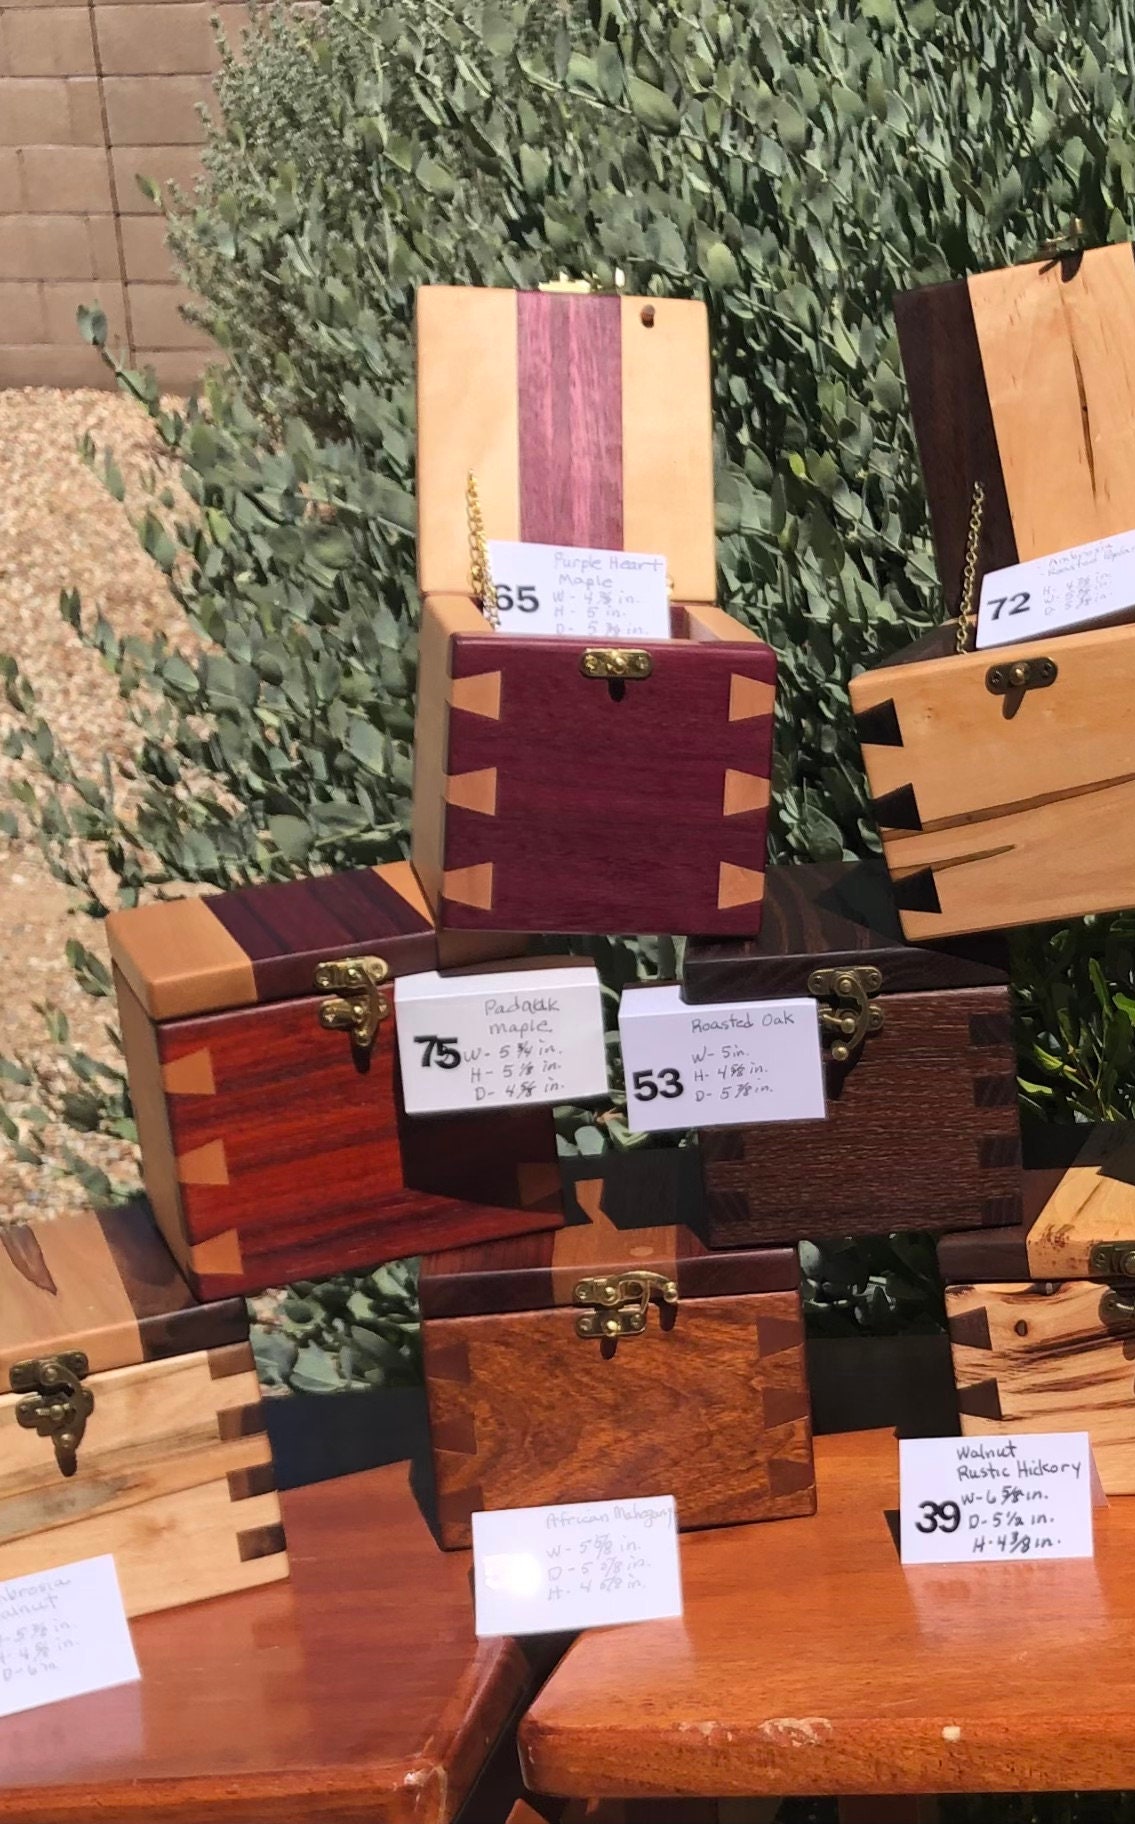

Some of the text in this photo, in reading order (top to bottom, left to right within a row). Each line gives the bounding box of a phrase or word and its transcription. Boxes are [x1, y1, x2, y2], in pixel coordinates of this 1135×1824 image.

[554, 552, 664, 572] Purple Heart
[558, 574, 613, 591] Maple
[495, 585, 539, 613] 65
[987, 592, 1031, 621] 72
[691, 1010, 795, 1034] Roasted Oak
[413, 1035, 461, 1069] 75
[538, 1039, 563, 1056] in.
[542, 1060, 562, 1073] in.
[750, 1062, 768, 1075] in.
[544, 1077, 565, 1093] in.
[632, 1067, 684, 1102] 53
[754, 1078, 774, 1095] in.
[956, 1440, 1018, 1461] Walnut
[956, 1460, 1082, 1482] Rustic Hickory
[546, 1510, 610, 1530] African
[915, 1500, 962, 1534] 39
[1031, 1514, 1055, 1526] in.
[620, 1535, 641, 1552] in.
[1035, 1537, 1062, 1549] in.
[626, 1555, 651, 1571] in.
[626, 1574, 646, 1589] in.
